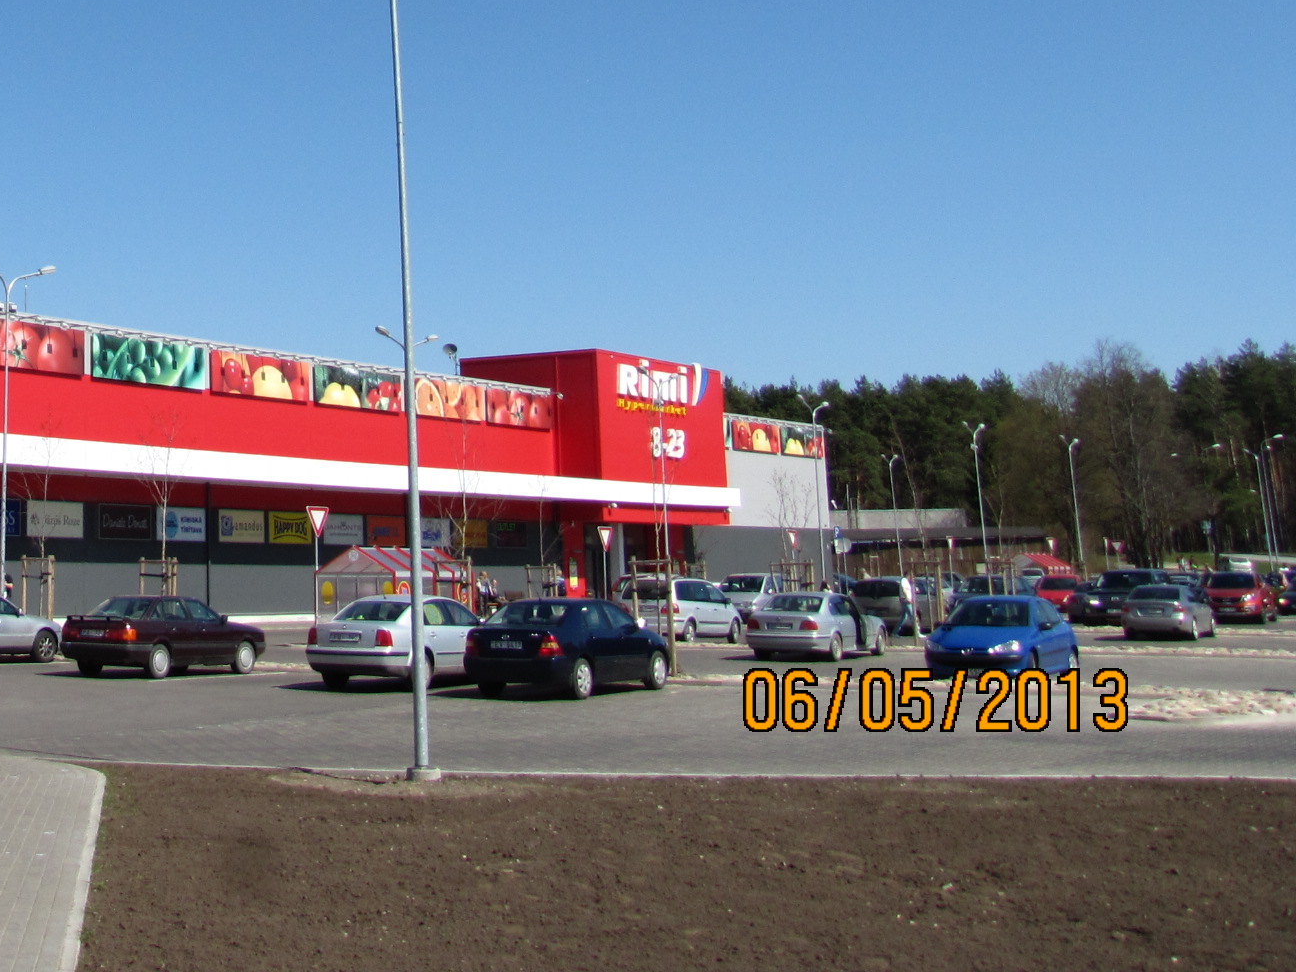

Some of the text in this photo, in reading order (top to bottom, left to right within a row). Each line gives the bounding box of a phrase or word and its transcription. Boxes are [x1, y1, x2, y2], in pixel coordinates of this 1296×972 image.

[617, 359, 688, 404] Rimi
[616, 398, 687, 416] Hypermarket
[650, 426, 685, 459] 8-23
[273, 519, 294, 535] HAPPY
